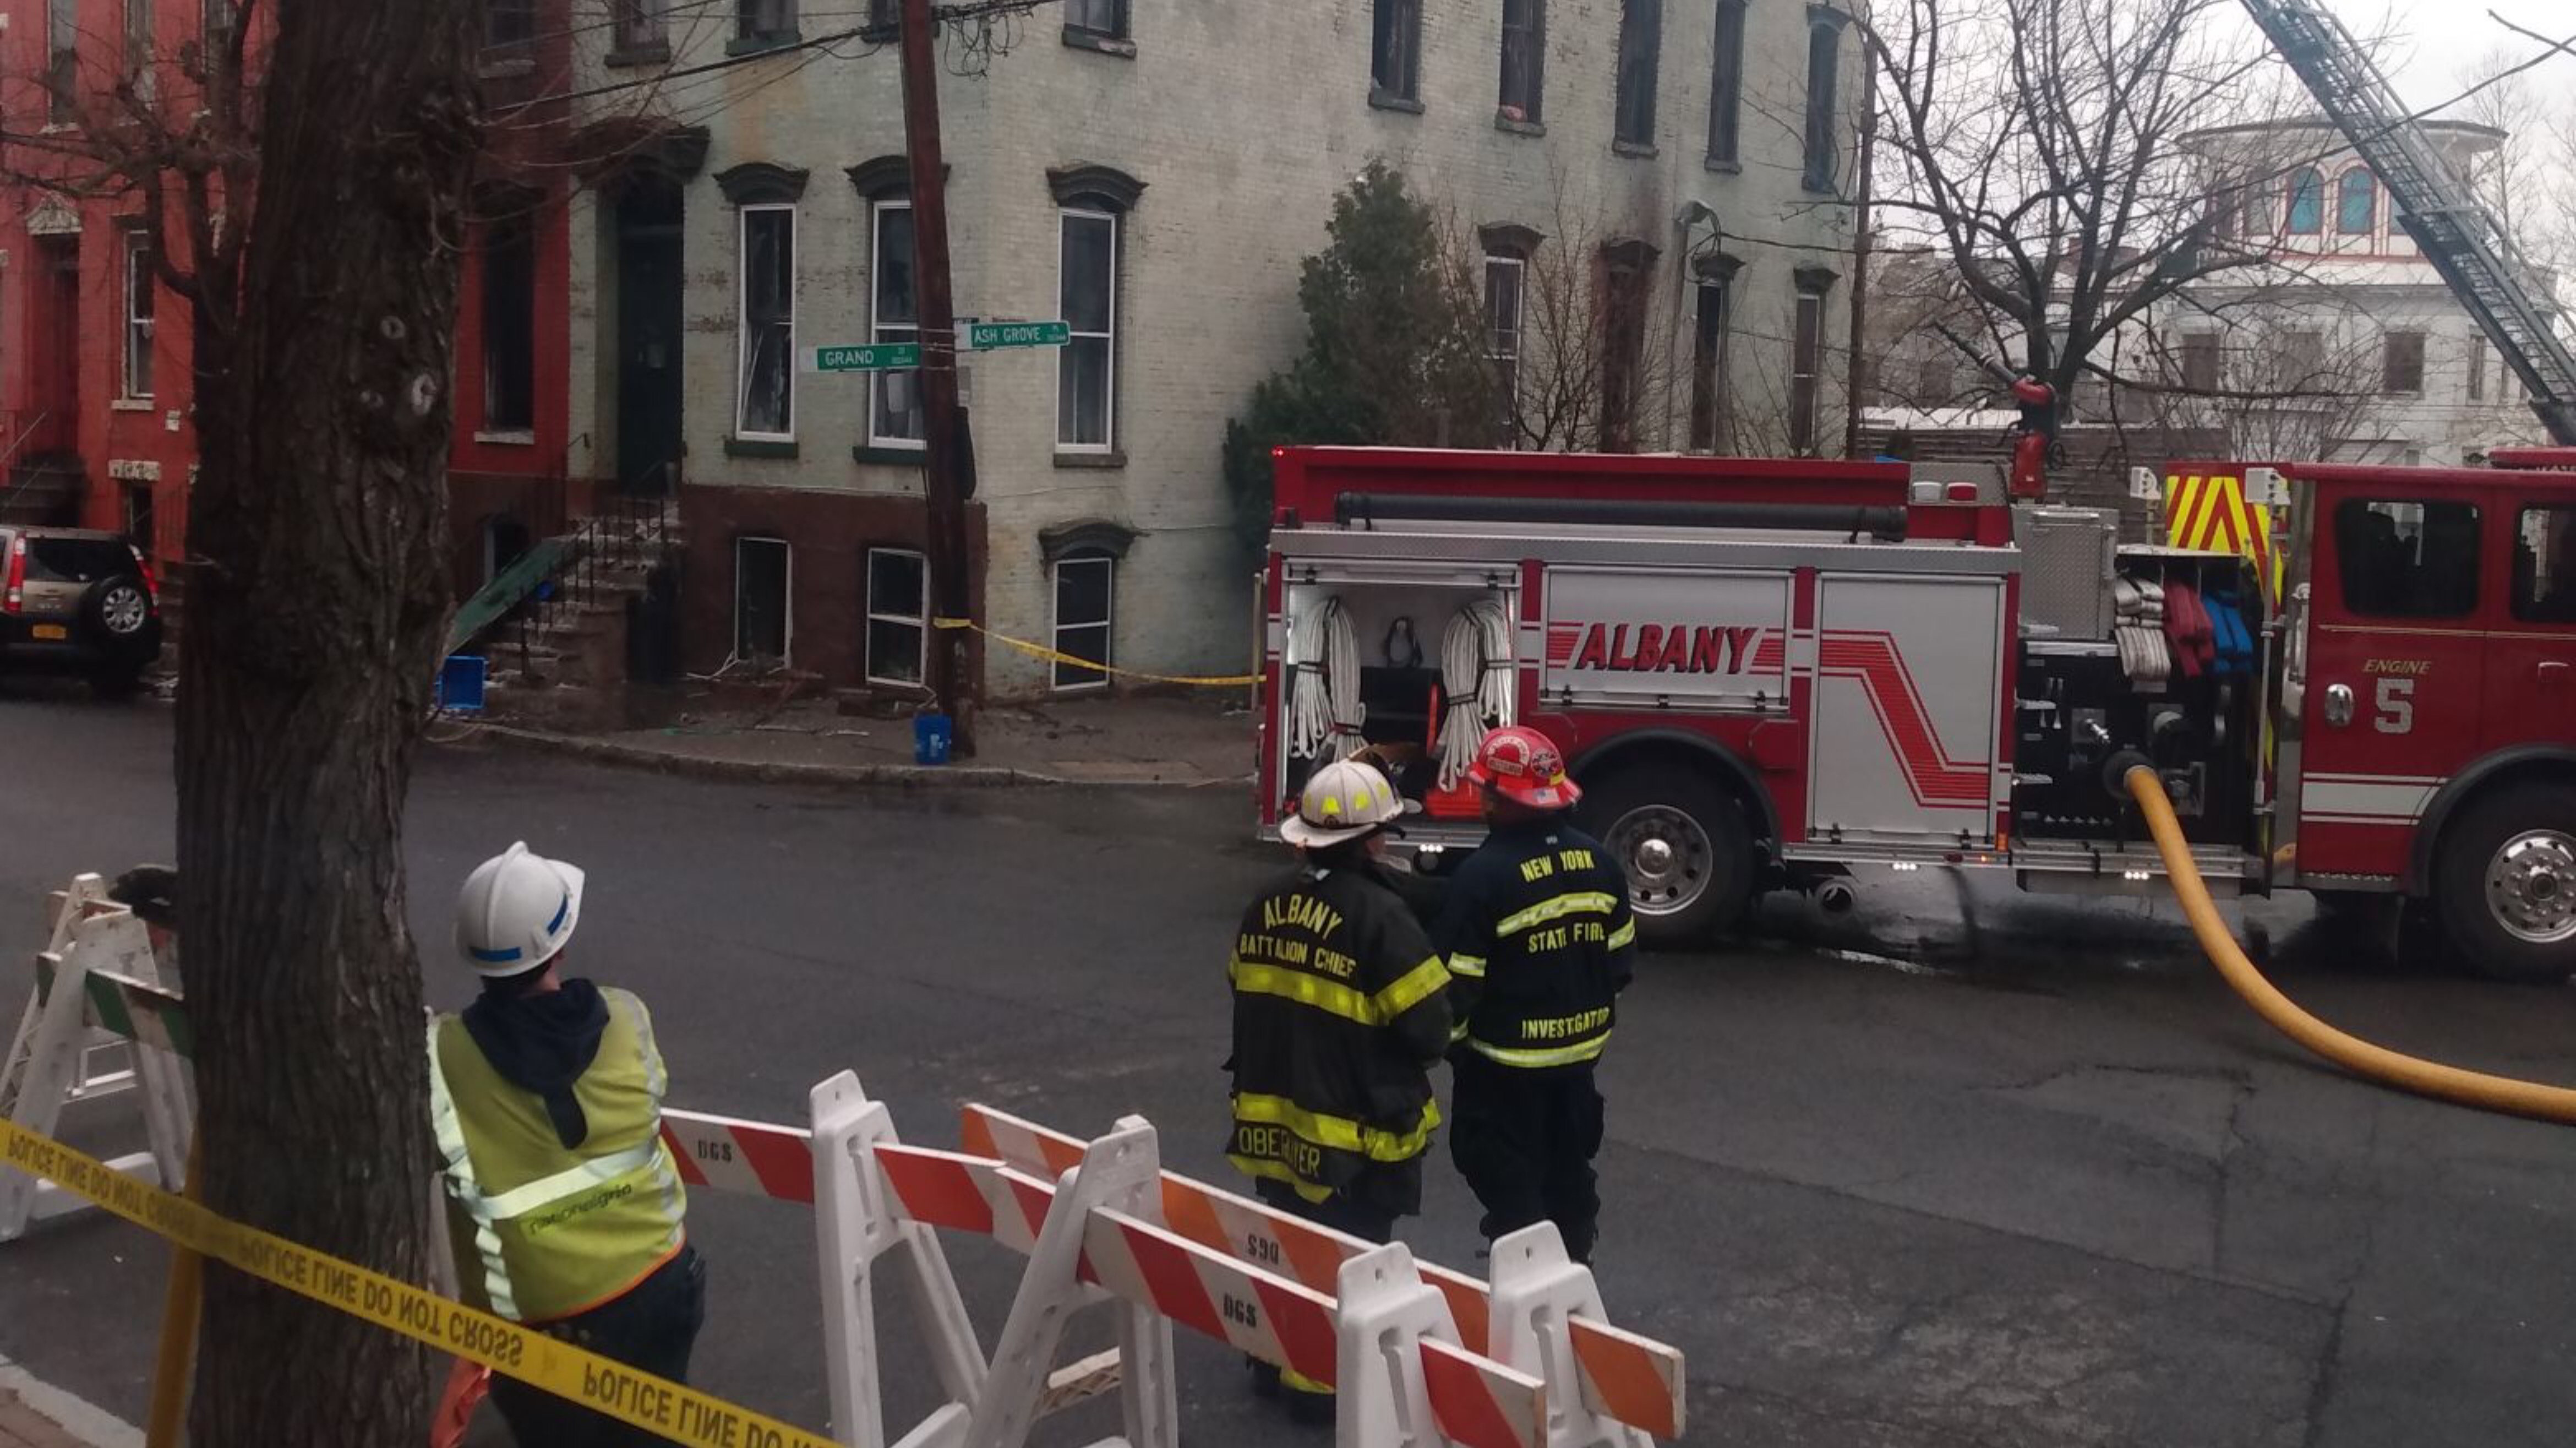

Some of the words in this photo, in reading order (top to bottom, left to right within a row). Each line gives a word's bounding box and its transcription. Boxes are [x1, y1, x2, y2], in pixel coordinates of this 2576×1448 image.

[974, 329, 997, 343] ASH
[1003, 326, 1041, 342] GROVE
[825, 350, 874, 366] GRAND
[1574, 623, 1759, 674] ALBANY
[2362, 658, 2432, 674] ENGINE
[2375, 678, 2414, 734] 5
[1520, 855, 1553, 883] NEW
[1559, 850, 1594, 872] YORK
[1264, 893, 1343, 940] ALBANY
[1240, 933, 1308, 964] BATTALION
[1314, 947, 1357, 978] CHIEF
[698, 1140, 733, 1162] DGS
[1223, 1292, 1257, 1328] DGS
